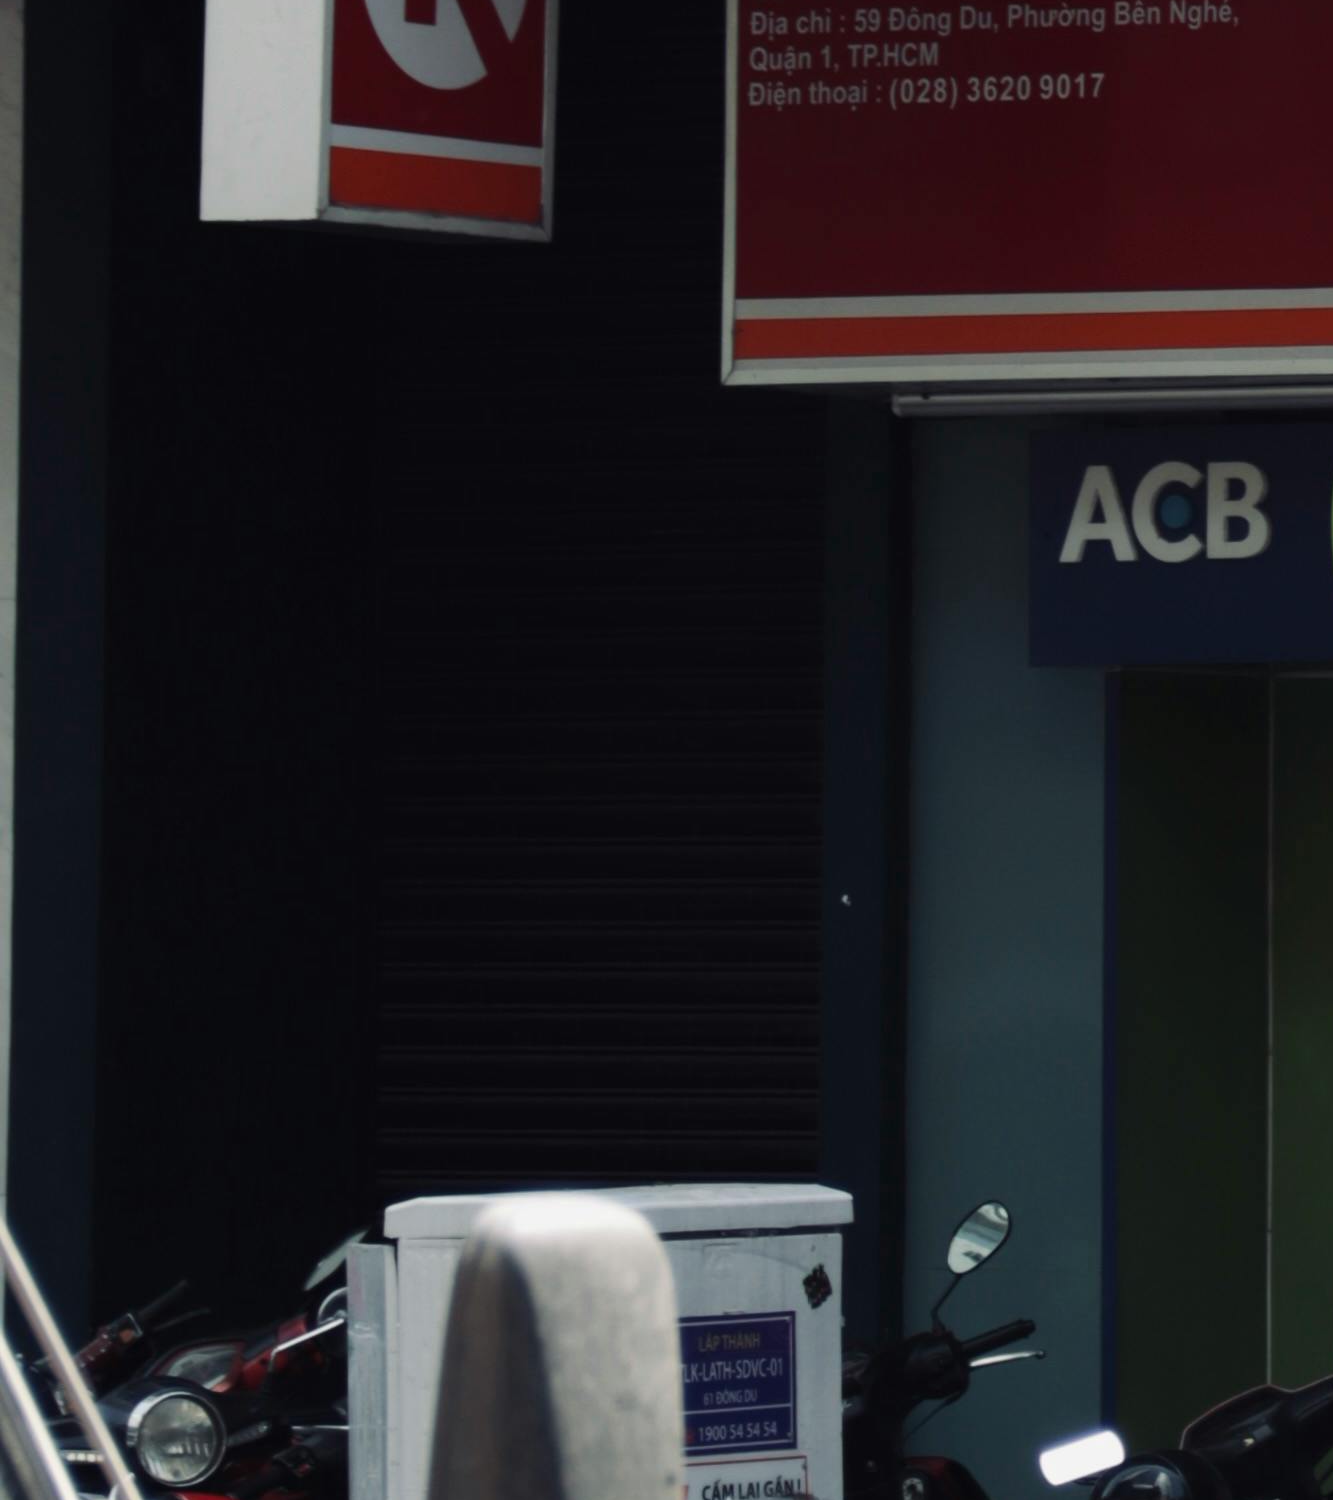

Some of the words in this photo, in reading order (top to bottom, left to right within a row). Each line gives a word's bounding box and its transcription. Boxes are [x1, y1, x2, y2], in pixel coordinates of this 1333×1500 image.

[751, 10, 789, 41] Địa
[853, 7, 882, 33] 59
[887, 7, 951, 37] Đông
[959, 4, 1000, 33] Du,
[1006, 1, 1106, 33] Phường
[749, 45, 812, 77] Quận
[820, 45, 841, 73] 1,
[847, 41, 940, 69] TP.HCM
[748, 80, 802, 112] Điện
[808, 79, 869, 112] thoại
[889, 77, 959, 111] (028)
[966, 74, 1032, 103] 3620
[1039, 72, 1106, 101] 9017
[1056, 460, 1274, 565] ACB
[698, 1425, 727, 1443] 1900
[728, 1423, 744, 1438] 54
[746, 1421, 761, 1438] 54
[763, 1420, 778, 1437] 54
